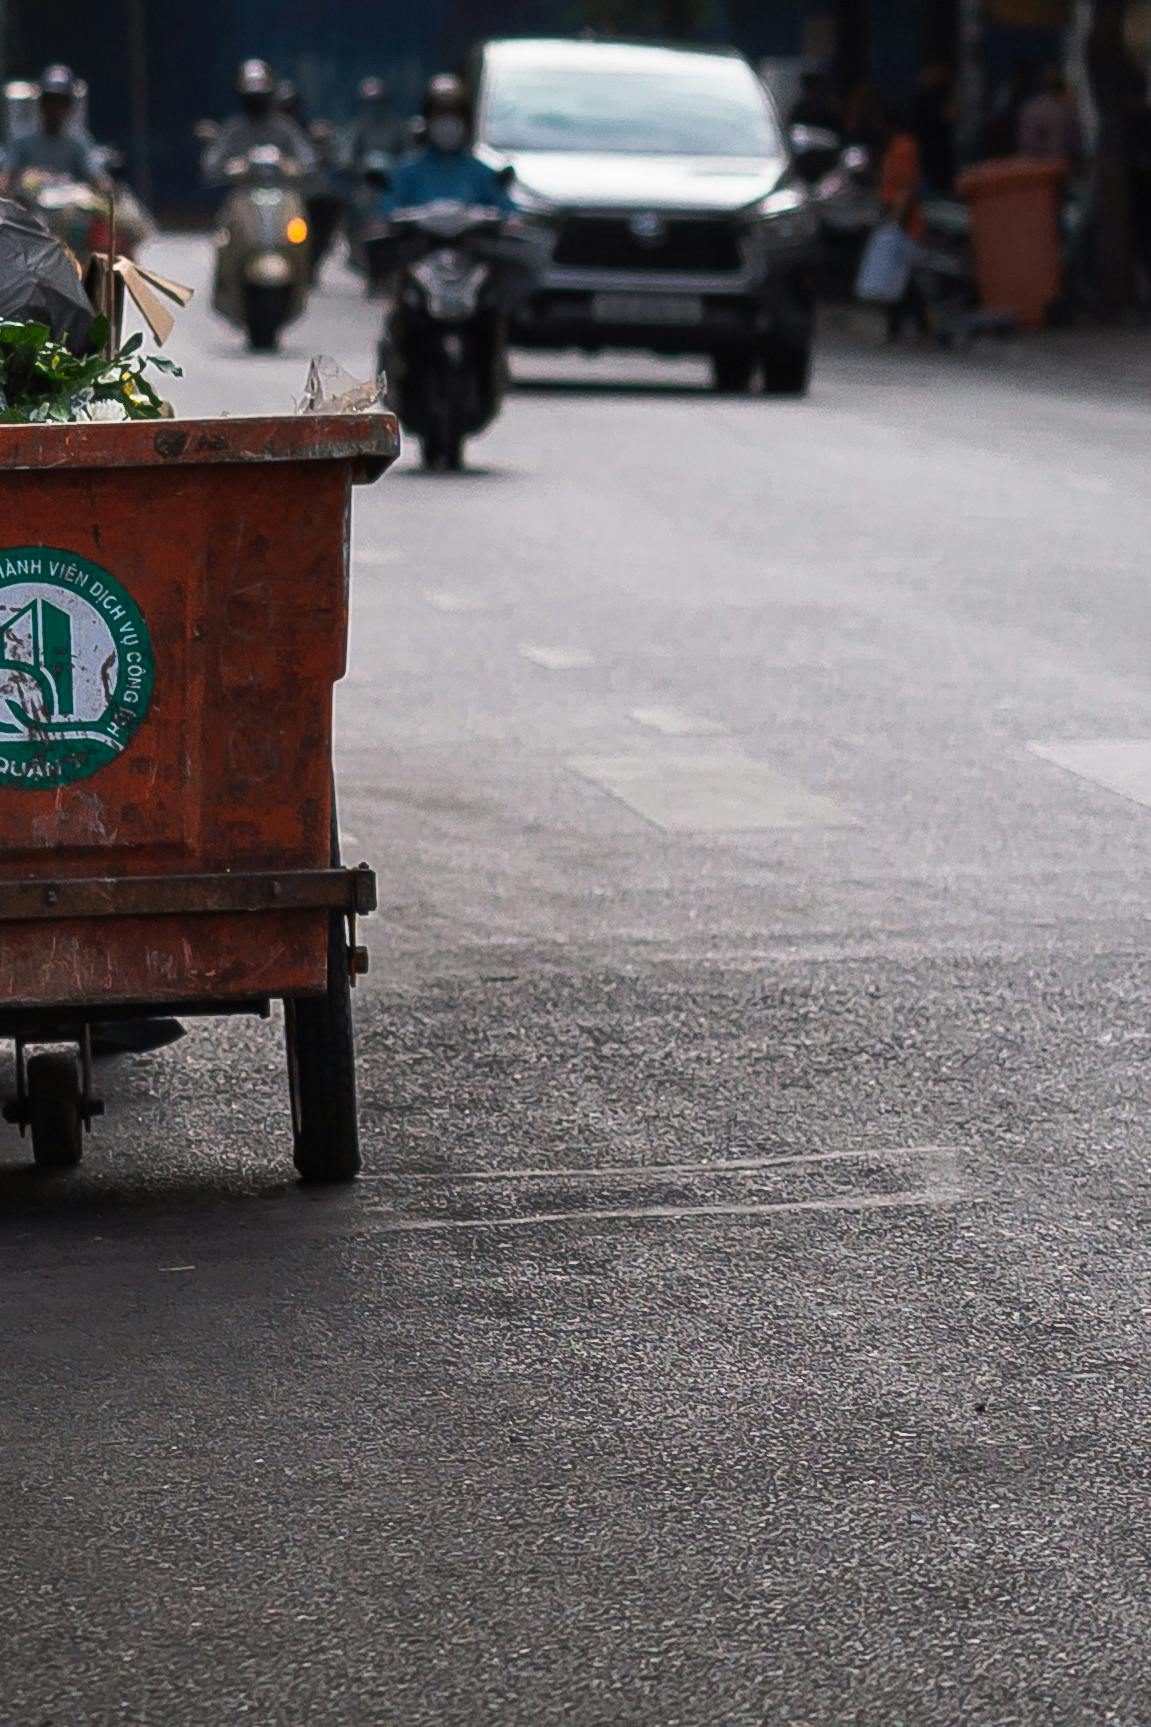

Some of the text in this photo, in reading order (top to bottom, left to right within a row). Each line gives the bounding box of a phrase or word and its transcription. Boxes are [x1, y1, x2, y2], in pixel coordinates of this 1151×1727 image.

[89, 580, 127, 621] DỊCH
[119, 620, 140, 647] VỤ
[123, 651, 147, 704] CÔNG
